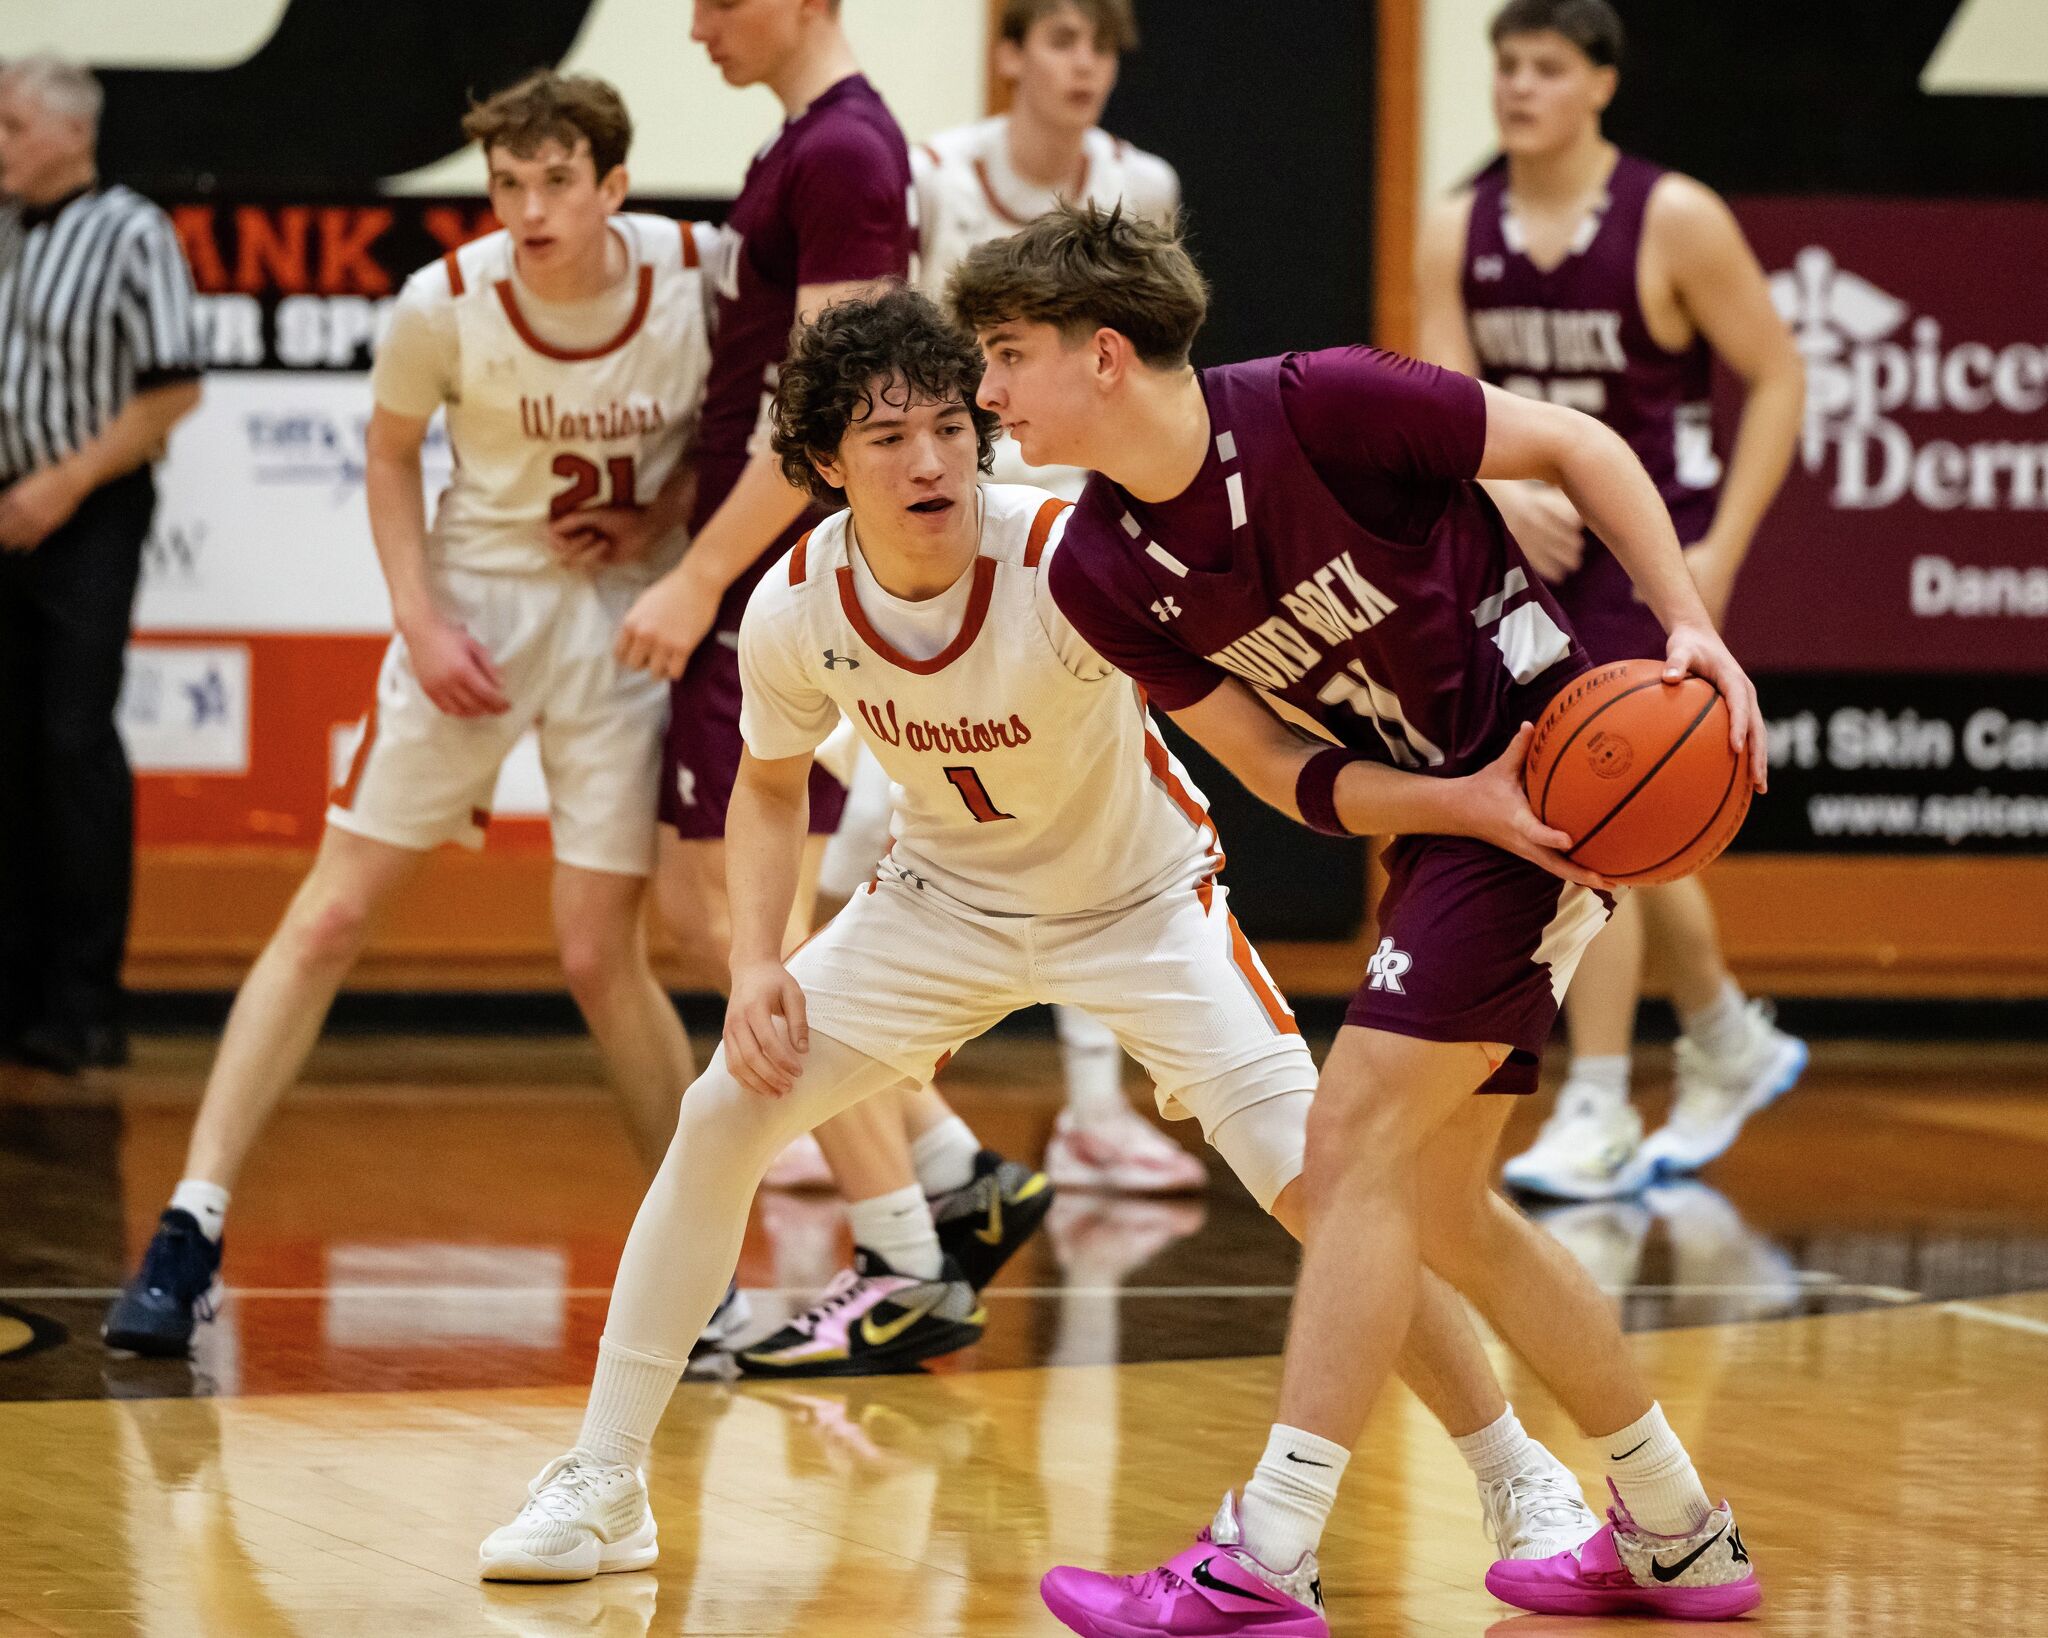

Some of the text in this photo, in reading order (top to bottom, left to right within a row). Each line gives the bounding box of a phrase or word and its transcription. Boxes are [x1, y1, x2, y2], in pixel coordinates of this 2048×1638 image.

[550, 454, 637, 522] 21
[857, 699, 1032, 754] Warriors
[942, 766, 1016, 824] 1
